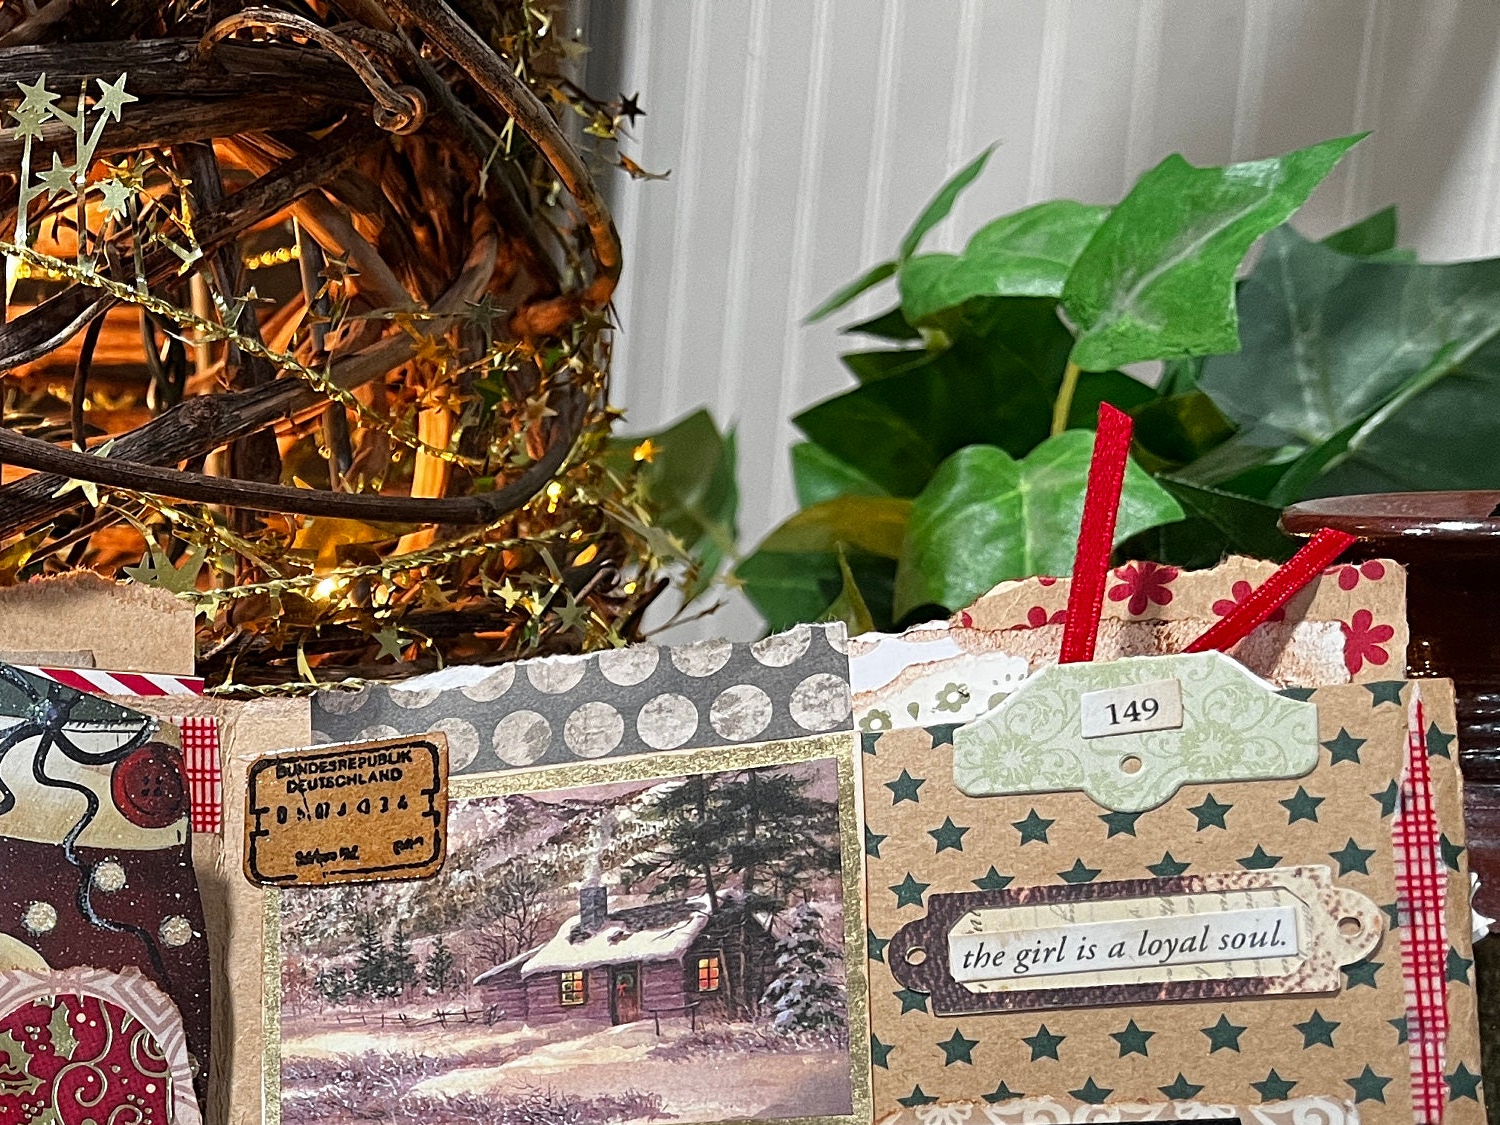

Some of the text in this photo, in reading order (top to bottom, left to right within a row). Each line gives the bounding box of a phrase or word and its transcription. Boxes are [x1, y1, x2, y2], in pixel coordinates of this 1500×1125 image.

[1104, 697, 1160, 727] 149
[286, 767, 404, 794] DEUTSCHLAND
[962, 918, 1287, 974] the girl is a loyal soul.
